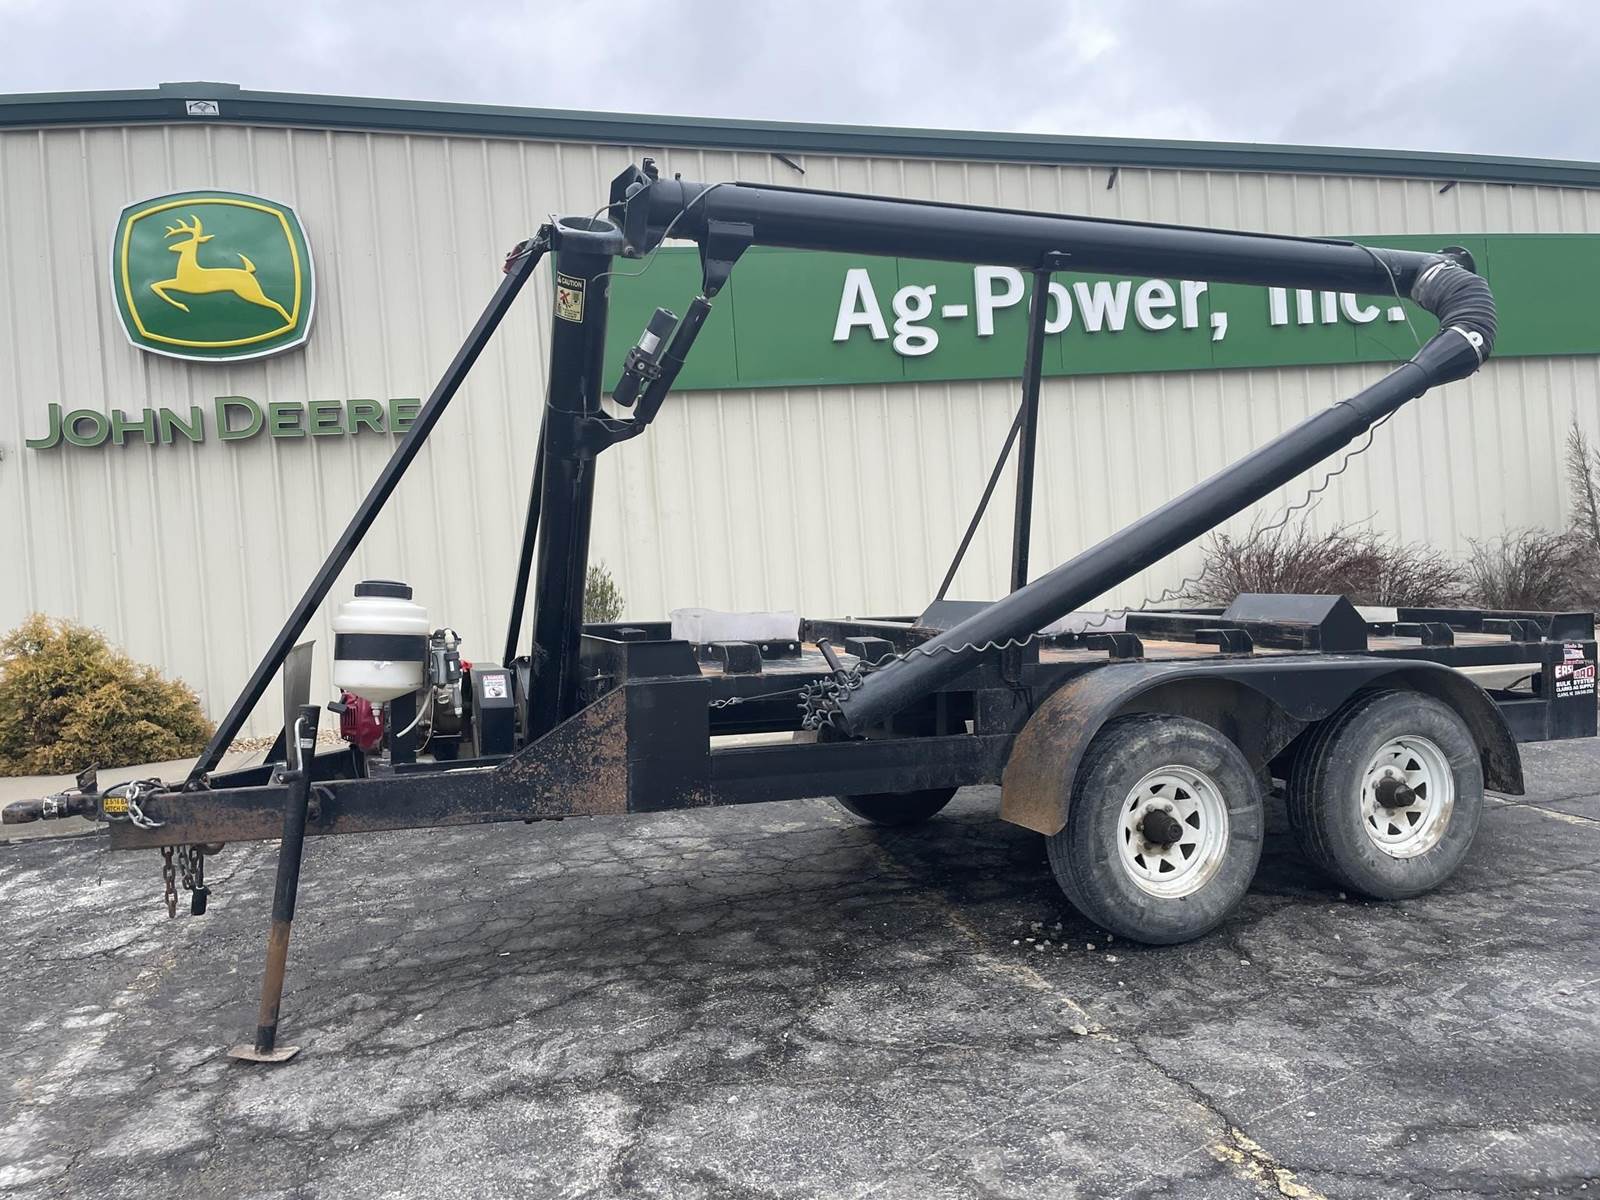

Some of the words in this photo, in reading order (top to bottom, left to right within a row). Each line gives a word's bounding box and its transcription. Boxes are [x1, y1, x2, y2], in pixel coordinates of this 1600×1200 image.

[561, 277, 583, 288] CAUTION
[832, 265, 1228, 356] Ag-Power,
[25, 402, 203, 449] JOHN
[214, 395, 422, 440] DEERE
